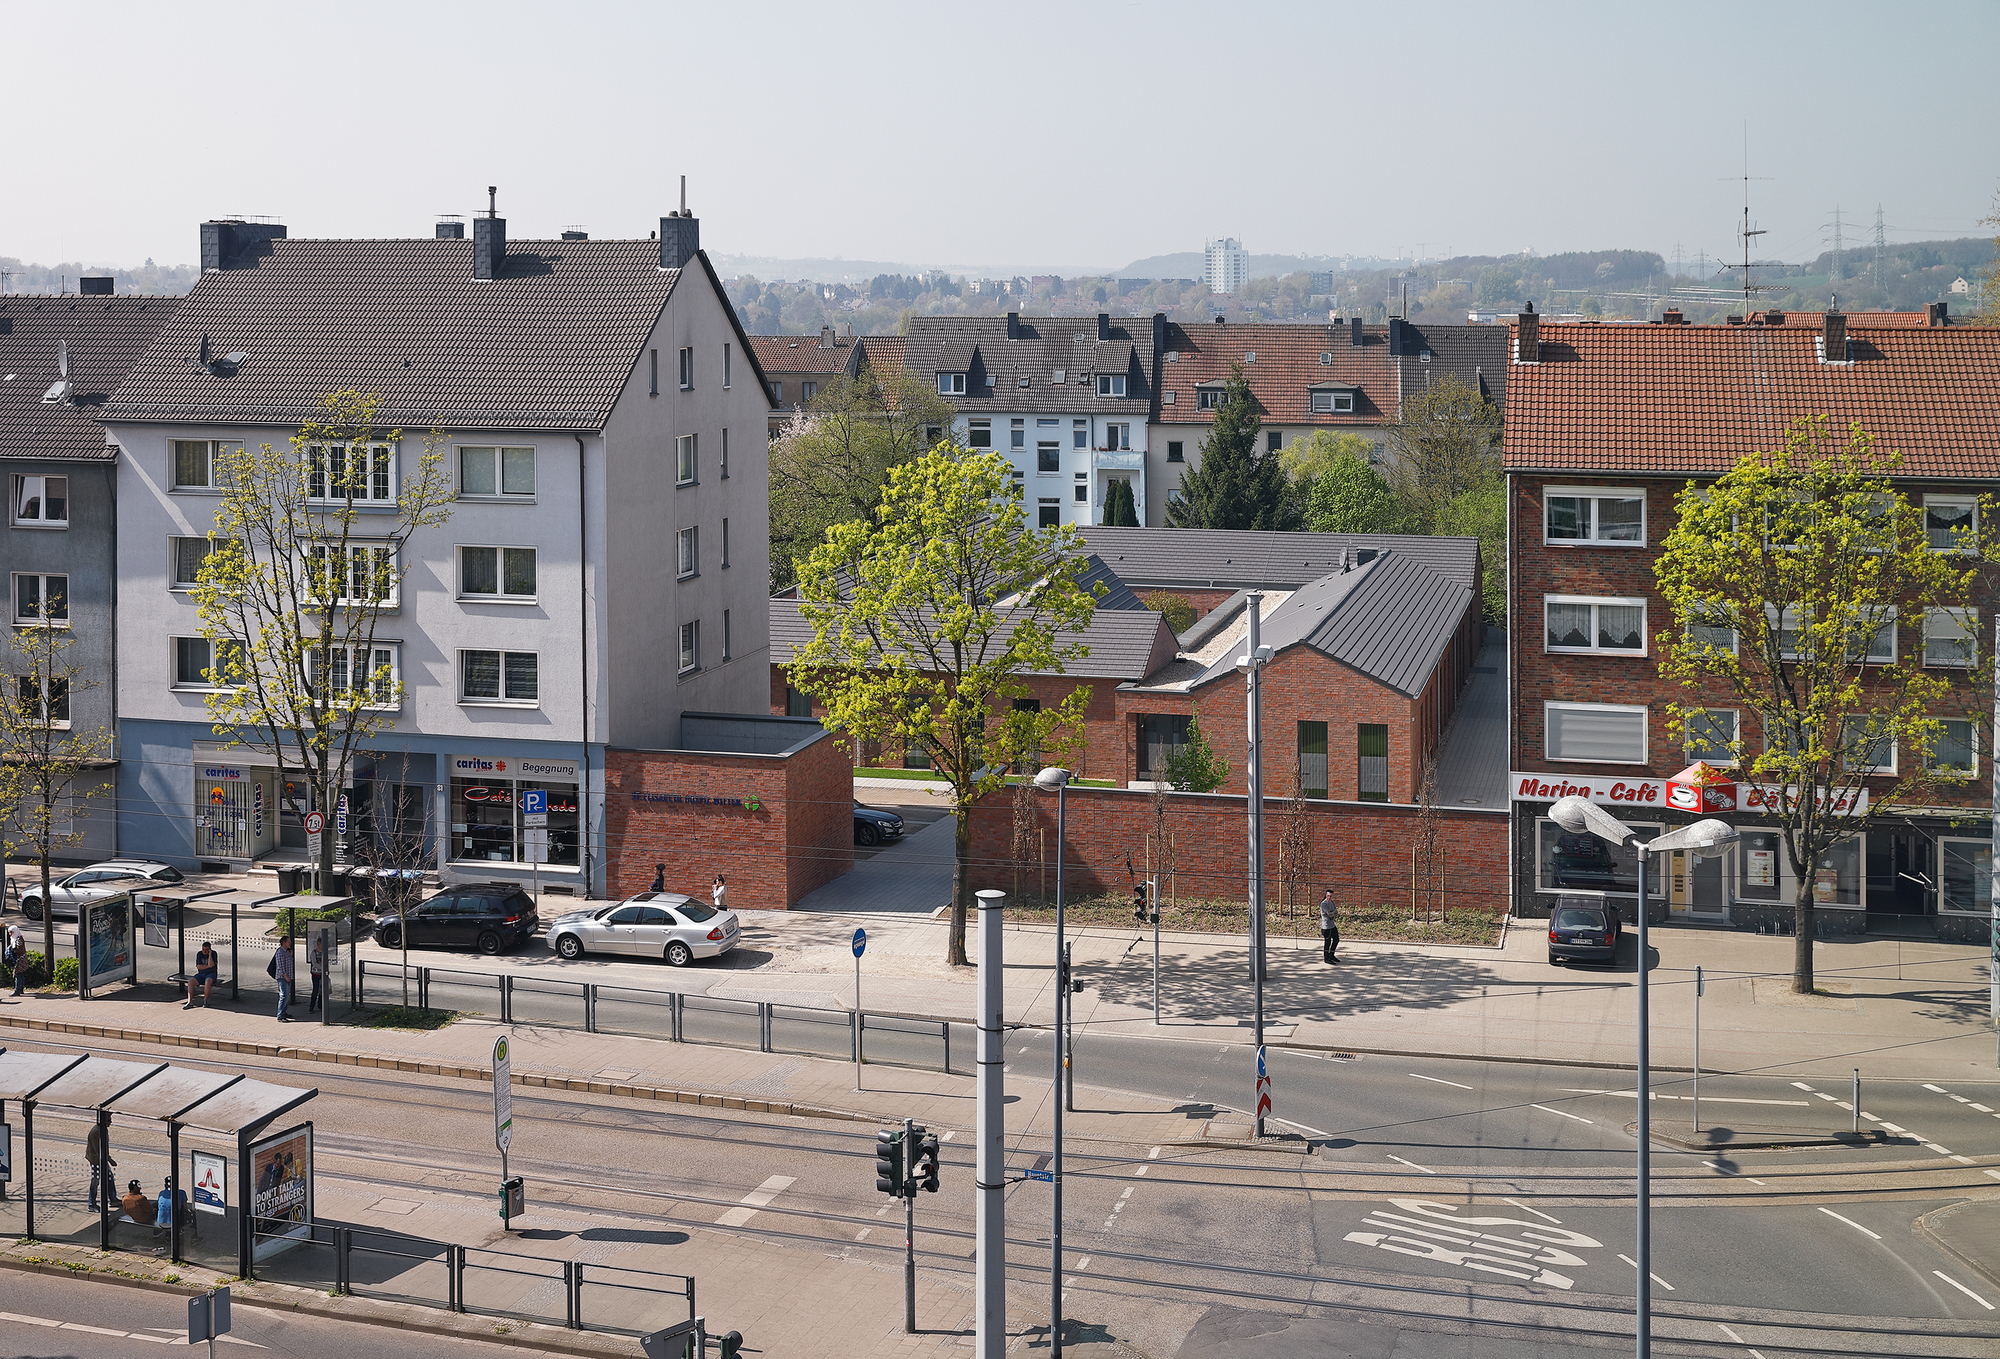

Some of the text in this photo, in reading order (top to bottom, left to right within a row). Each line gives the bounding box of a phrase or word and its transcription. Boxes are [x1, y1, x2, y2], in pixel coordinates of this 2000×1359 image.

[205, 765, 240, 778] caritas
[456, 757, 493, 770] caritas
[522, 762, 574, 776] Begegnung
[464, 786, 512, 803] Café
[1518, 778, 1591, 799] Marien
[1609, 782, 1660, 801] Café
[527, 794, 540, 811] P
[631, 791, 740, 807] ST. ELISABETH HOSPIZ WITTEN
[253, 783, 262, 836] caritas
[337, 795, 347, 833] caritas
[256, 1180, 295, 1204] DON'T TALK
[256, 1202, 266, 1214] TO
[267, 1185, 305, 1210] STRANGERS
